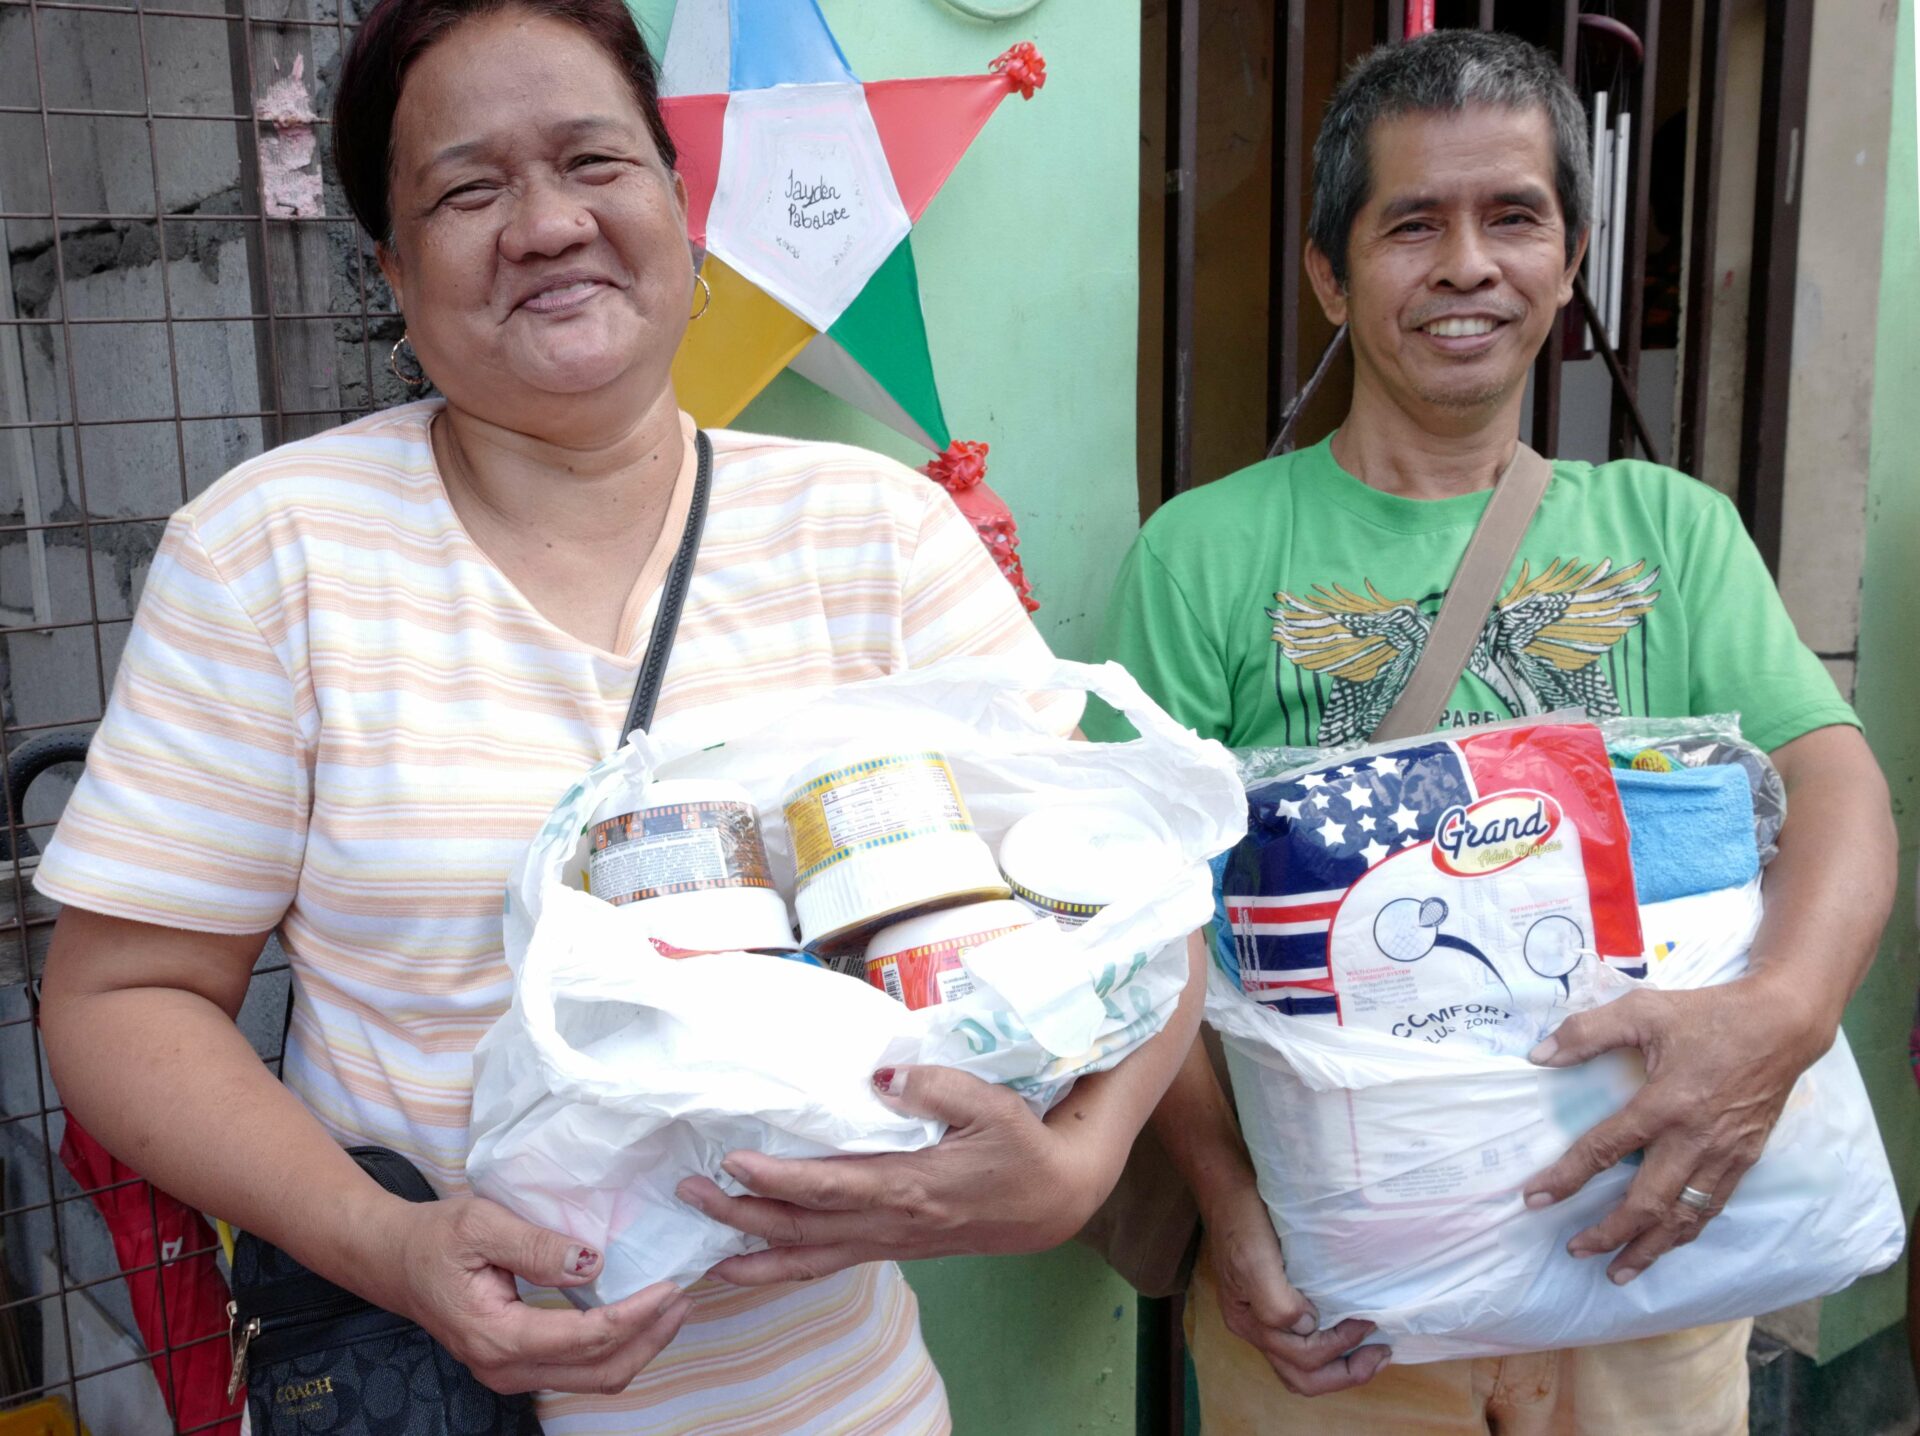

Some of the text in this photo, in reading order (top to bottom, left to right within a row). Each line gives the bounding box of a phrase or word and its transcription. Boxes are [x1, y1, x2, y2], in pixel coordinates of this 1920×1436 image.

[785, 169, 841, 208] Jayden
[788, 203, 851, 230] Pabalate
[1437, 800, 1549, 860] Grand
[1464, 1017, 1505, 1031] ZONE
[275, 1376, 334, 1404] COACH
